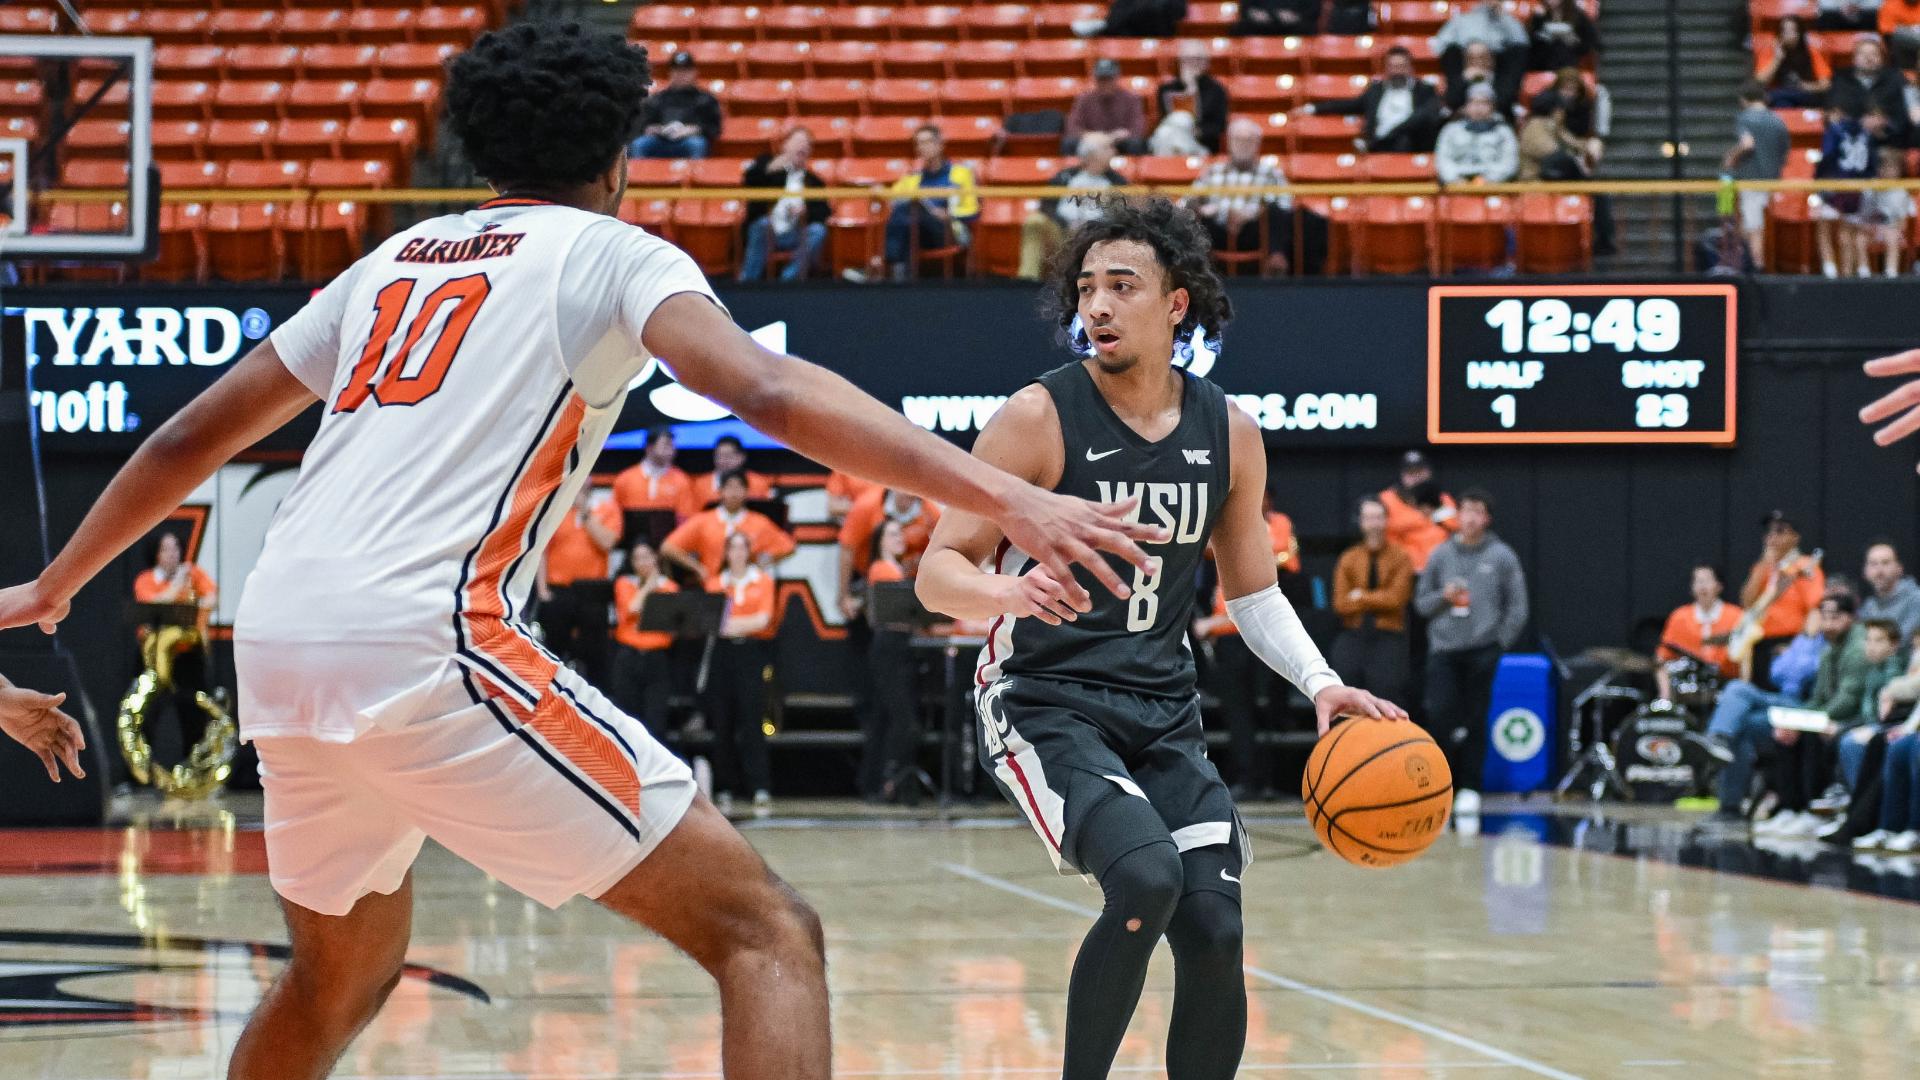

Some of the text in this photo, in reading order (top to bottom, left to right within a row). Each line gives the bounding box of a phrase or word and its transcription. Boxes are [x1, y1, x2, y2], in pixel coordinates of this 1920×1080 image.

[394, 232, 527, 264] GARDNER
[1485, 298, 1680, 353] 12:49
[331, 272, 492, 415] 10
[1467, 361, 1544, 389] HALF
[1622, 360, 1705, 389] SHOT
[1490, 394, 1516, 428] 1
[1635, 393, 1690, 428] 23
[1126, 555, 1164, 633] 8
